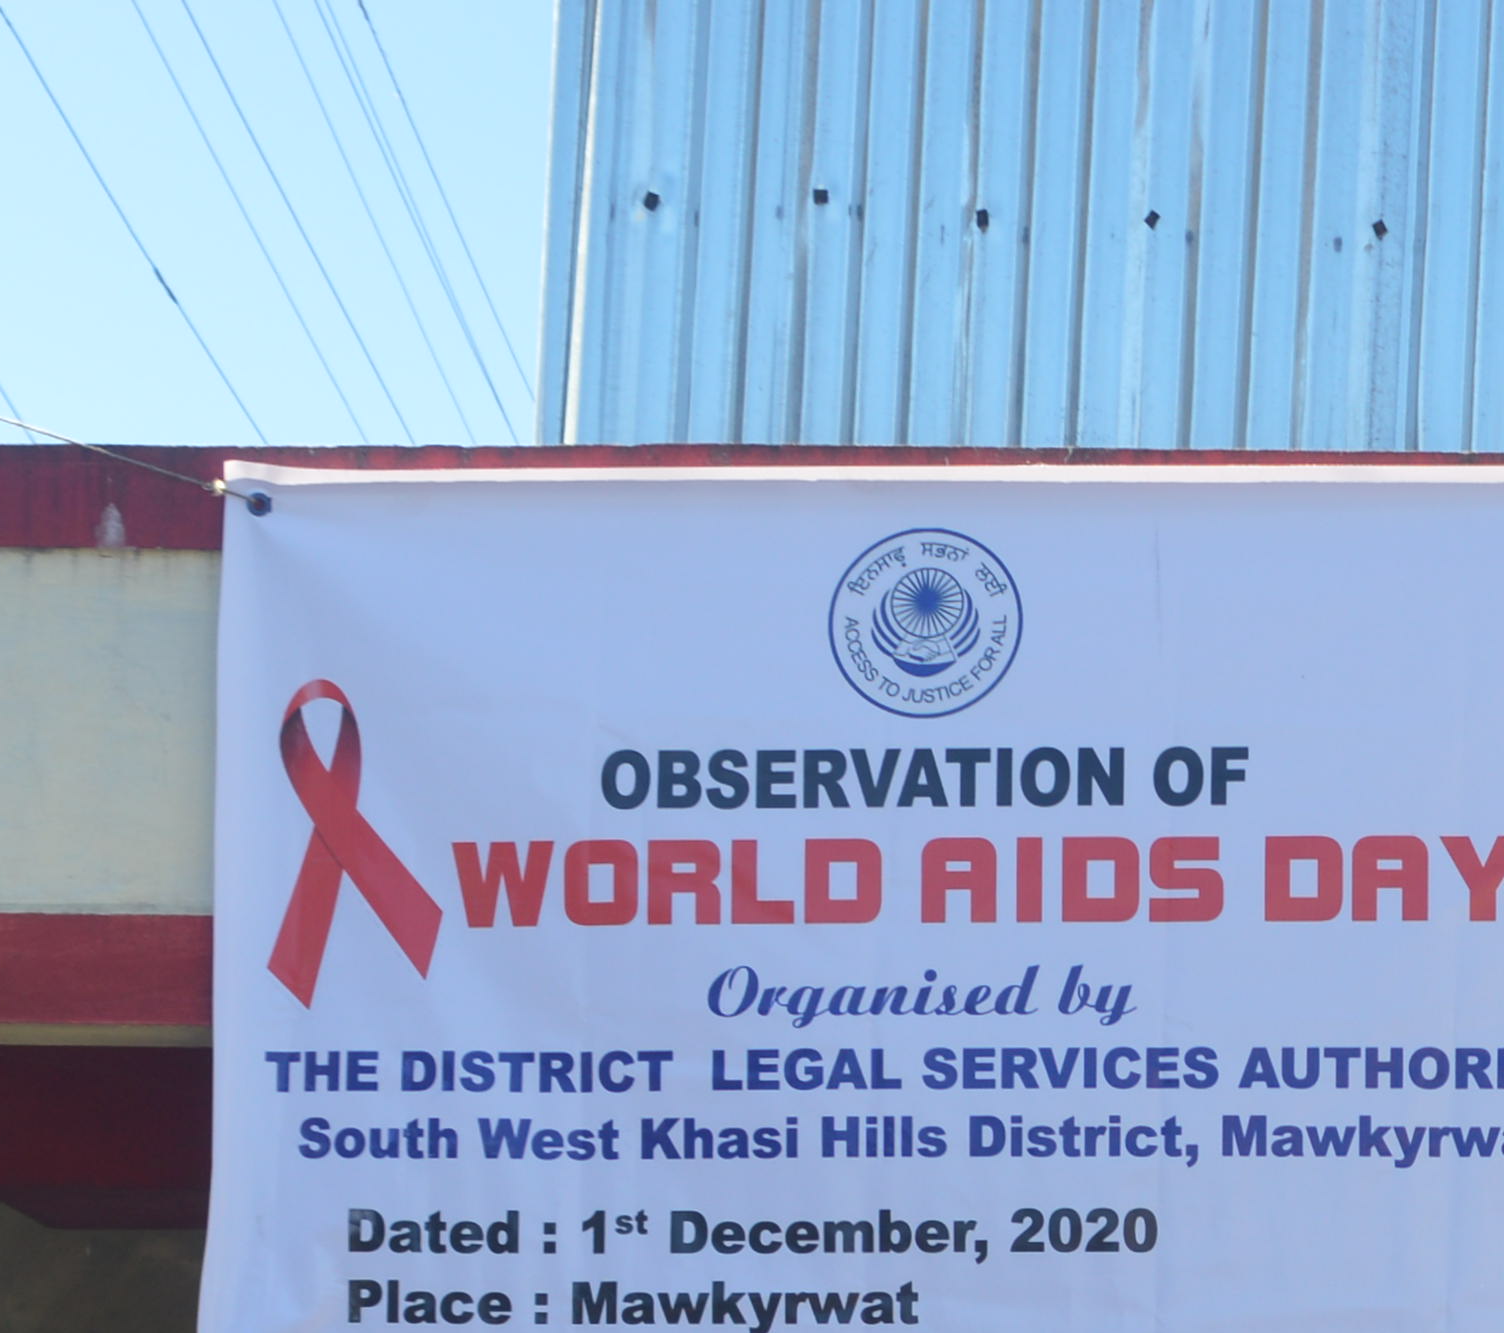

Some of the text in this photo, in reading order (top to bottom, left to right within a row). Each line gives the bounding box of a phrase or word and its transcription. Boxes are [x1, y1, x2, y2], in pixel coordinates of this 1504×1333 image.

[844, 614, 1008, 704] ACCESS TO JUSTICE FOR ALL
[602, 747, 1250, 811] OBSERVATION OF
[452, 839, 883, 929] WORLD
[922, 837, 1225, 924] AIDS
[708, 965, 1138, 1030] Organised by
[265, 1051, 380, 1094] THE
[401, 1051, 675, 1094] DISTRICT
[713, 1049, 903, 1092] LEGAL
[923, 1047, 1220, 1091] SERVICES
[299, 1118, 459, 1160] South
[478, 1119, 620, 1162] West
[641, 1117, 799, 1161] Khasi
[822, 1116, 948, 1159] Hills
[970, 1116, 1200, 1169] District,
[349, 1209, 521, 1255] Dated
[583, 1210, 649, 1255] 1st
[670, 1209, 989, 1264] December,
[1011, 1208, 1159, 1254] 2020
[348, 1280, 514, 1326] Place
